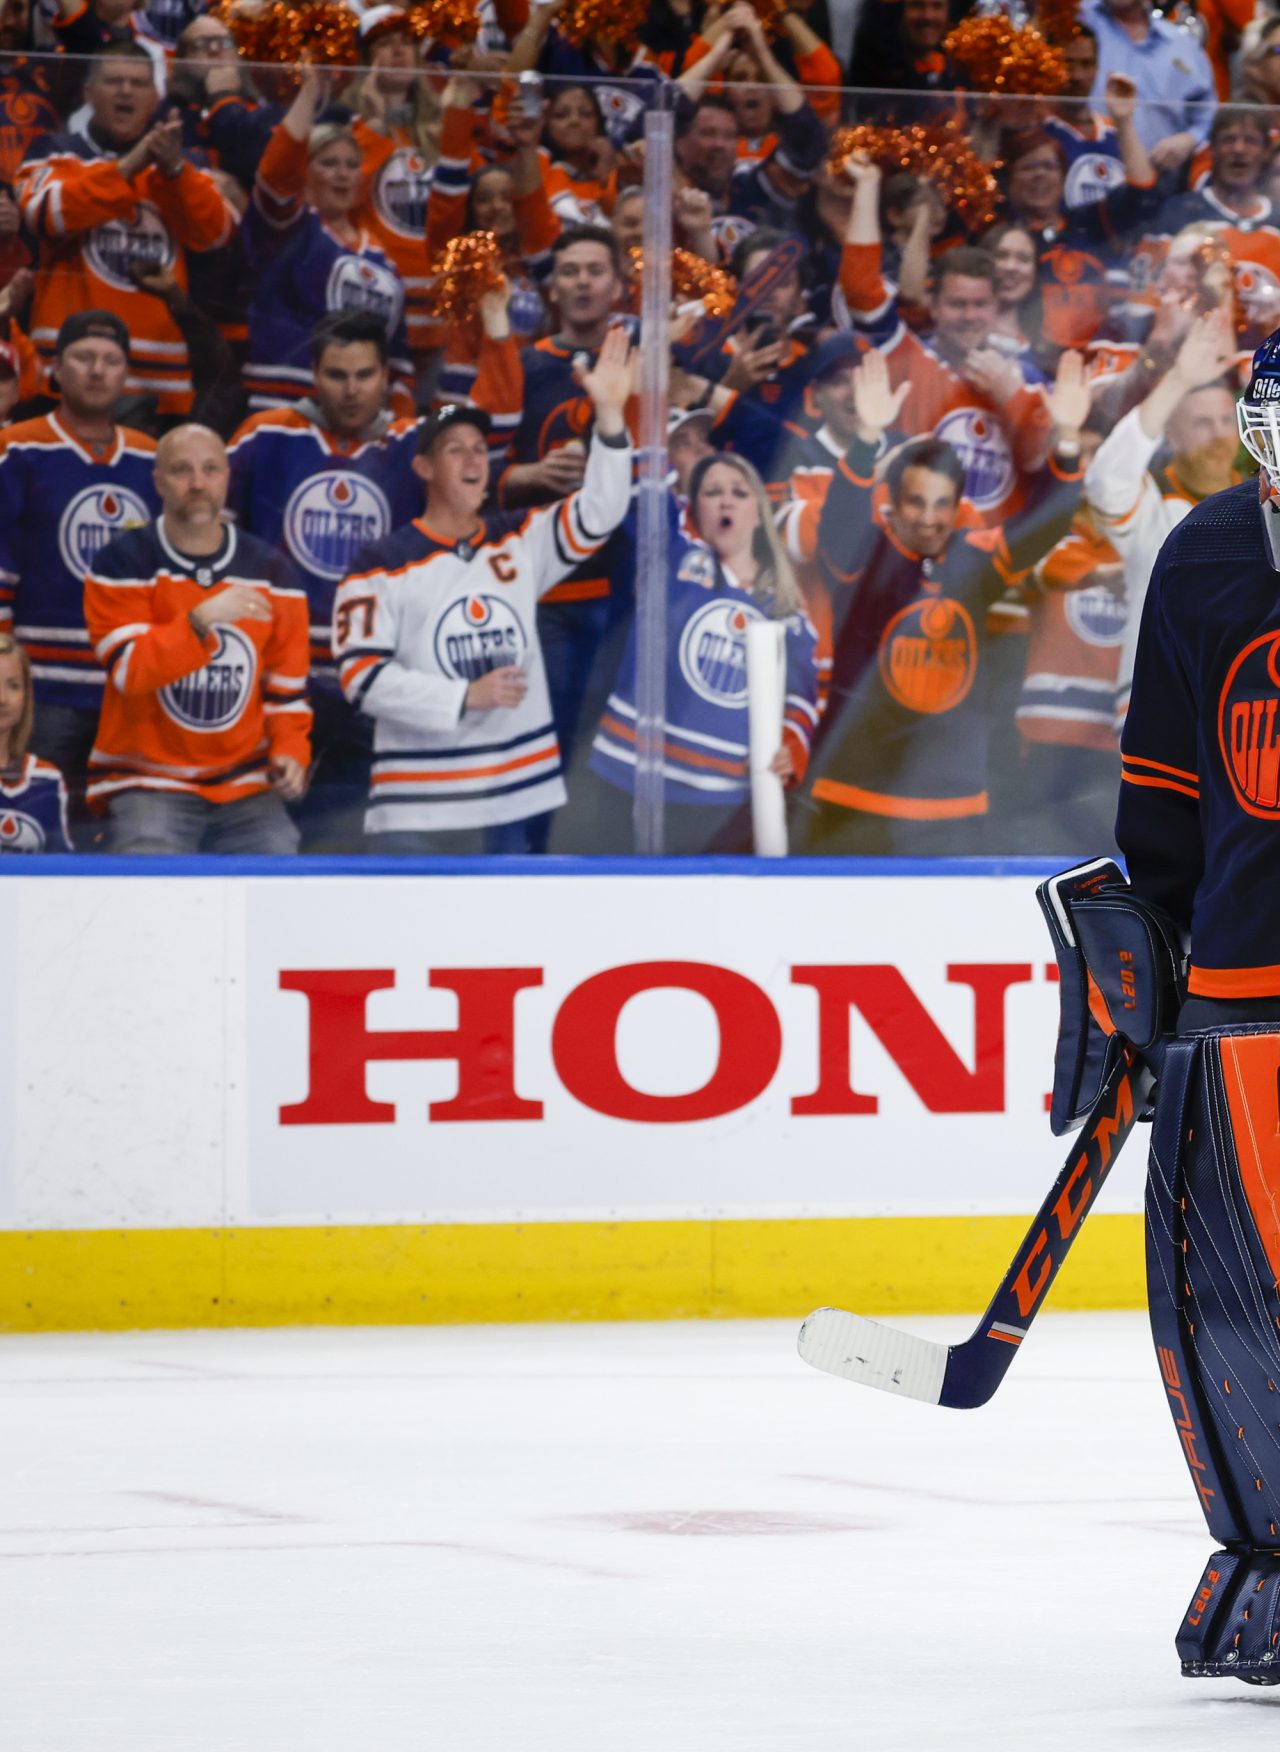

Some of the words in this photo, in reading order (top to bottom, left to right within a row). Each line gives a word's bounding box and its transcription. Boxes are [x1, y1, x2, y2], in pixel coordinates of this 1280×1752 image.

[487, 552, 517, 584] C
[1119, 950, 1137, 1010] L20.2
[279, 961, 1061, 1126] HON
[1009, 1072, 1134, 1318] CCM
[1158, 1345, 1215, 1512] TRUE
[1187, 1569, 1221, 1627] L20.2
